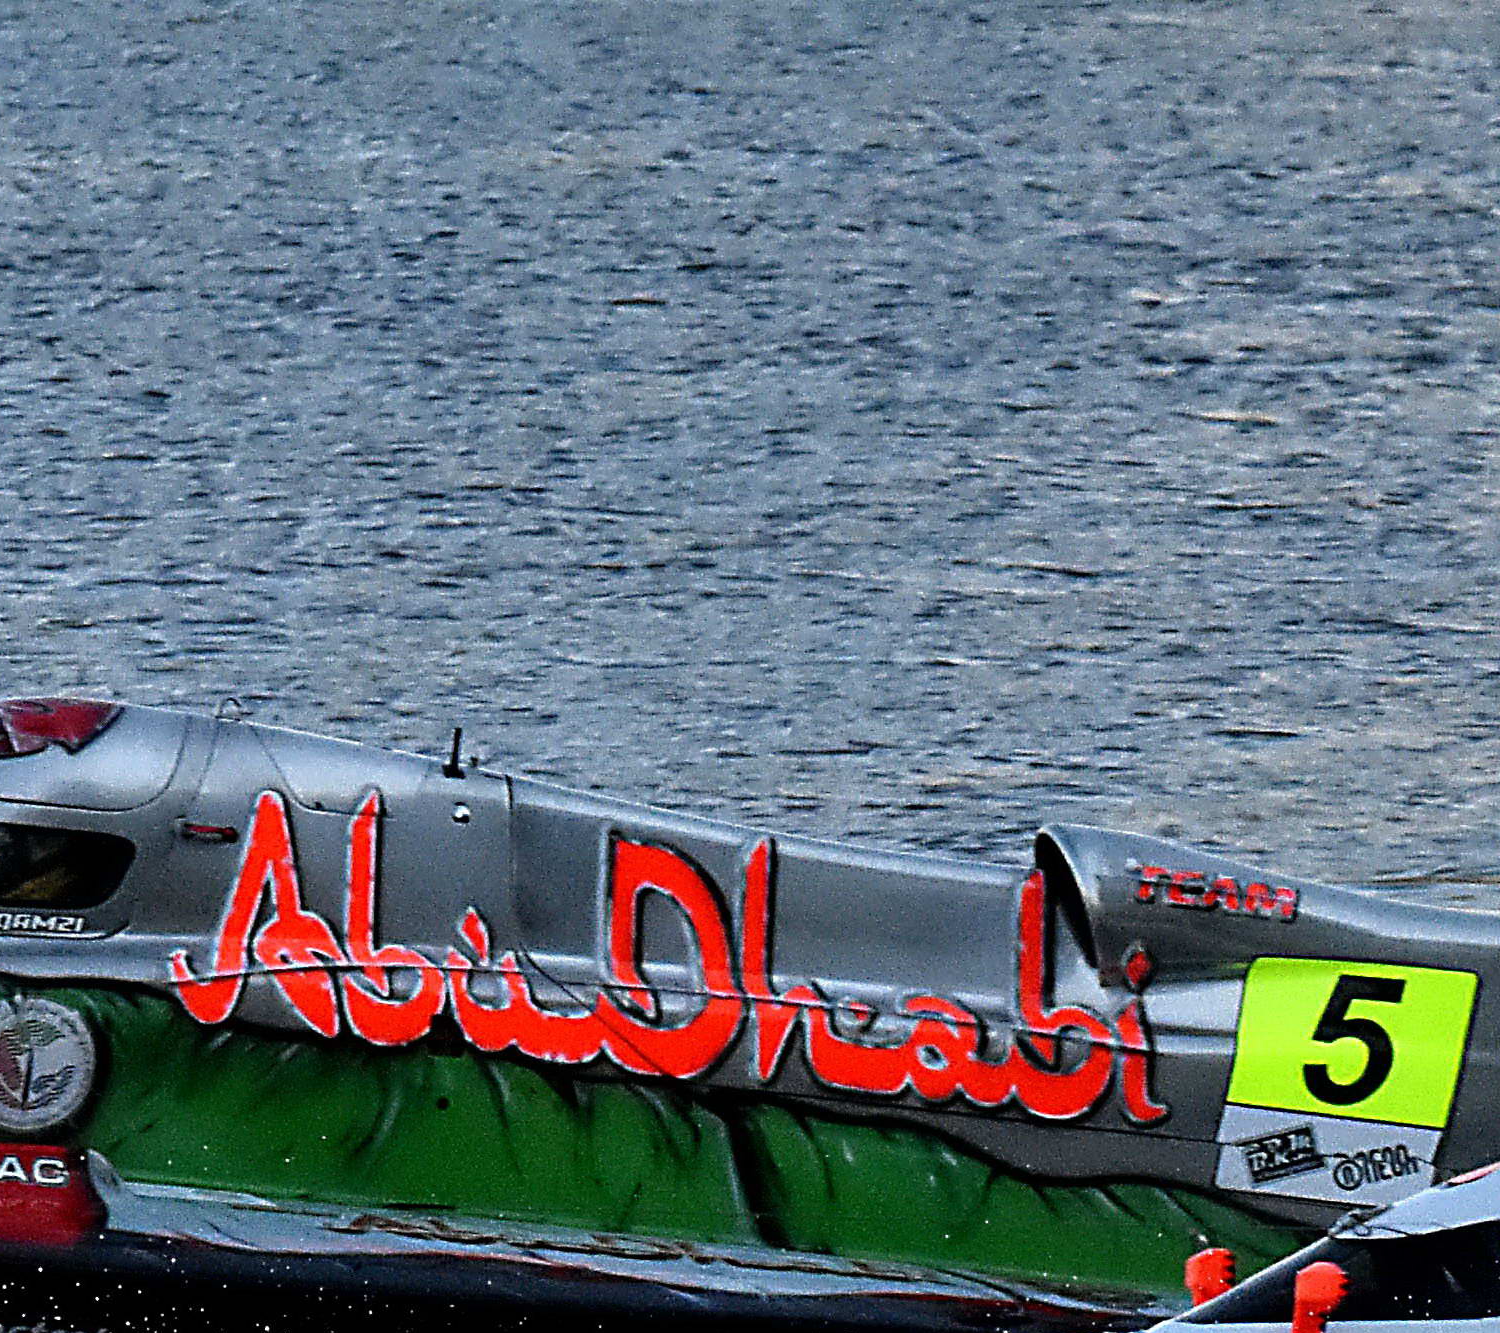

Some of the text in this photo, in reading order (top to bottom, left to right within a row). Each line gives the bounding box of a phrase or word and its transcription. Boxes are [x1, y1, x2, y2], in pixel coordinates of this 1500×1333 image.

[166, 788, 1168, 1126] Abu Dhabi
[1132, 863, 1300, 922] TEAM
[1301, 973, 1406, 1107] 5
